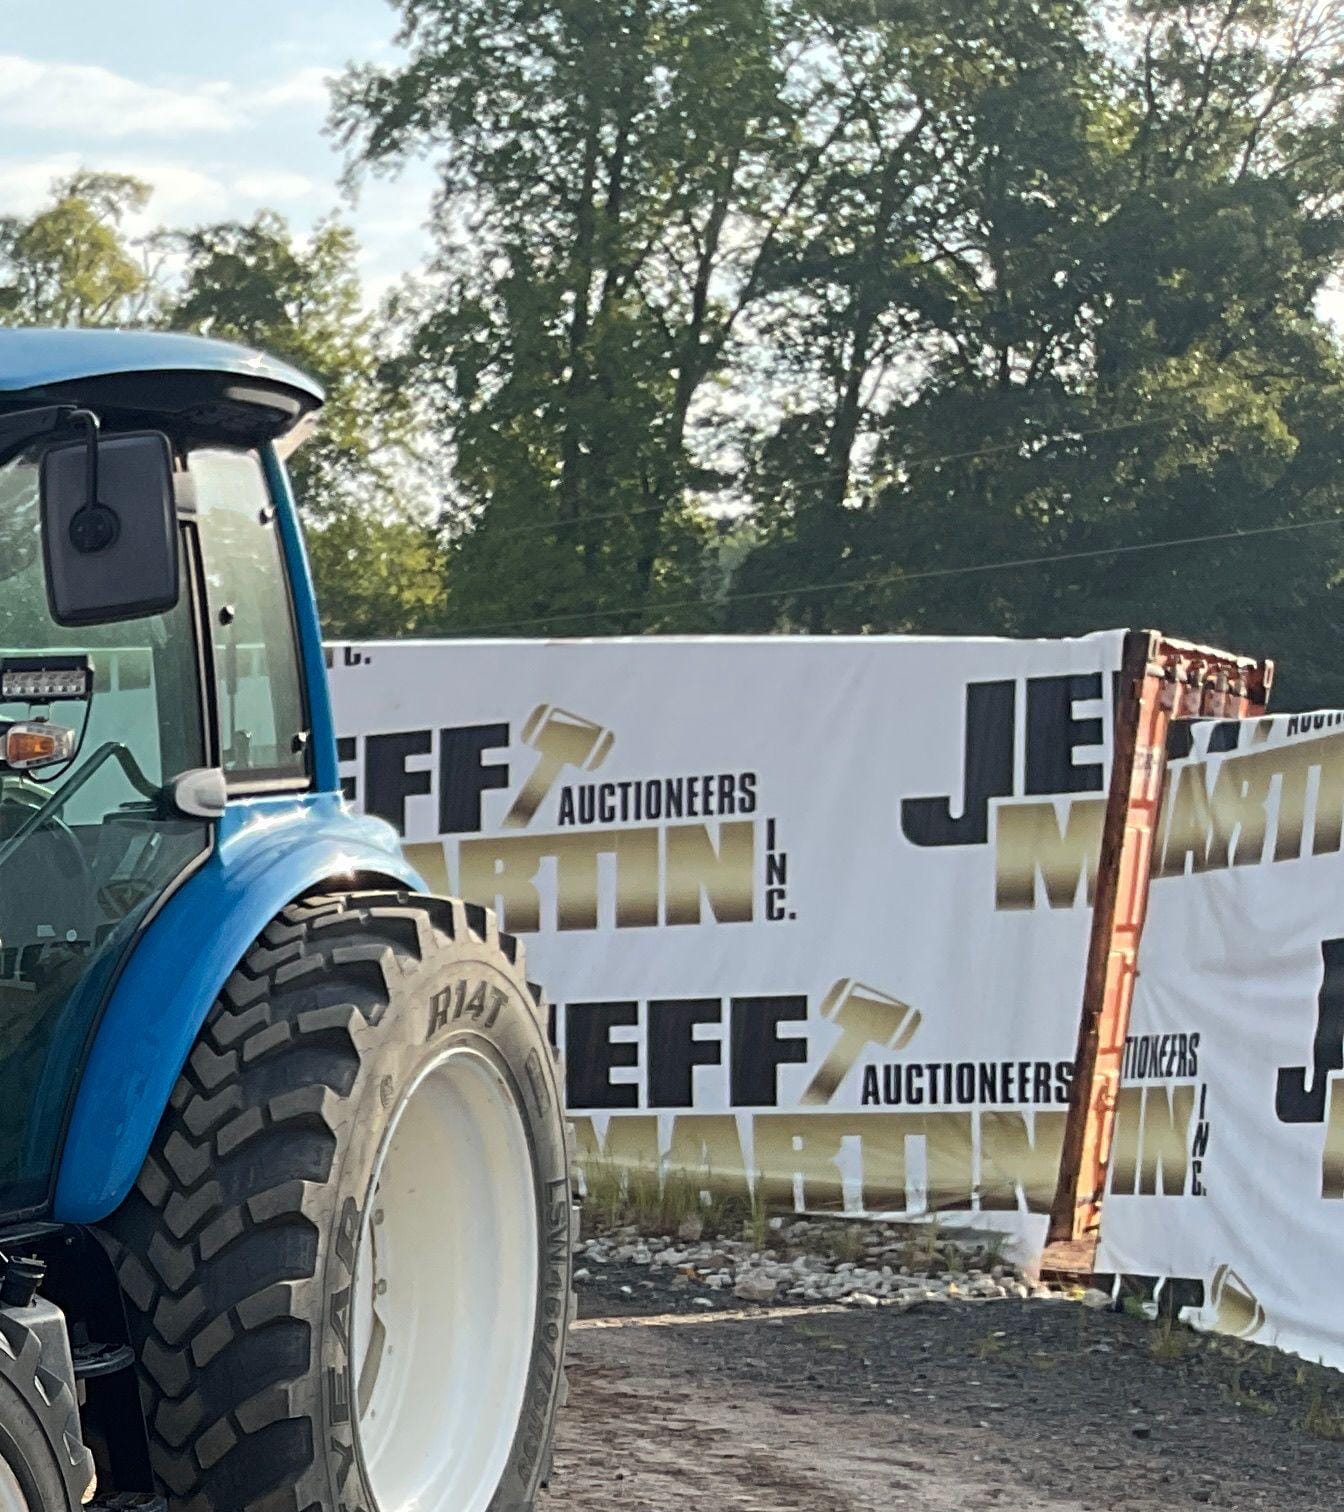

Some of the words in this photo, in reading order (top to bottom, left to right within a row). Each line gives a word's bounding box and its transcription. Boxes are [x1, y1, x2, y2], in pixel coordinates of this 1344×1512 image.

[558, 772, 757, 826] AUCTIONEERS
[764, 818, 797, 922] INC.
[425, 979, 510, 1042] R14T
[548, 994, 809, 1109] EFF
[1123, 1032, 1201, 1079] TIONEERS
[862, 1061, 1075, 1106] AUCTIONEERS
